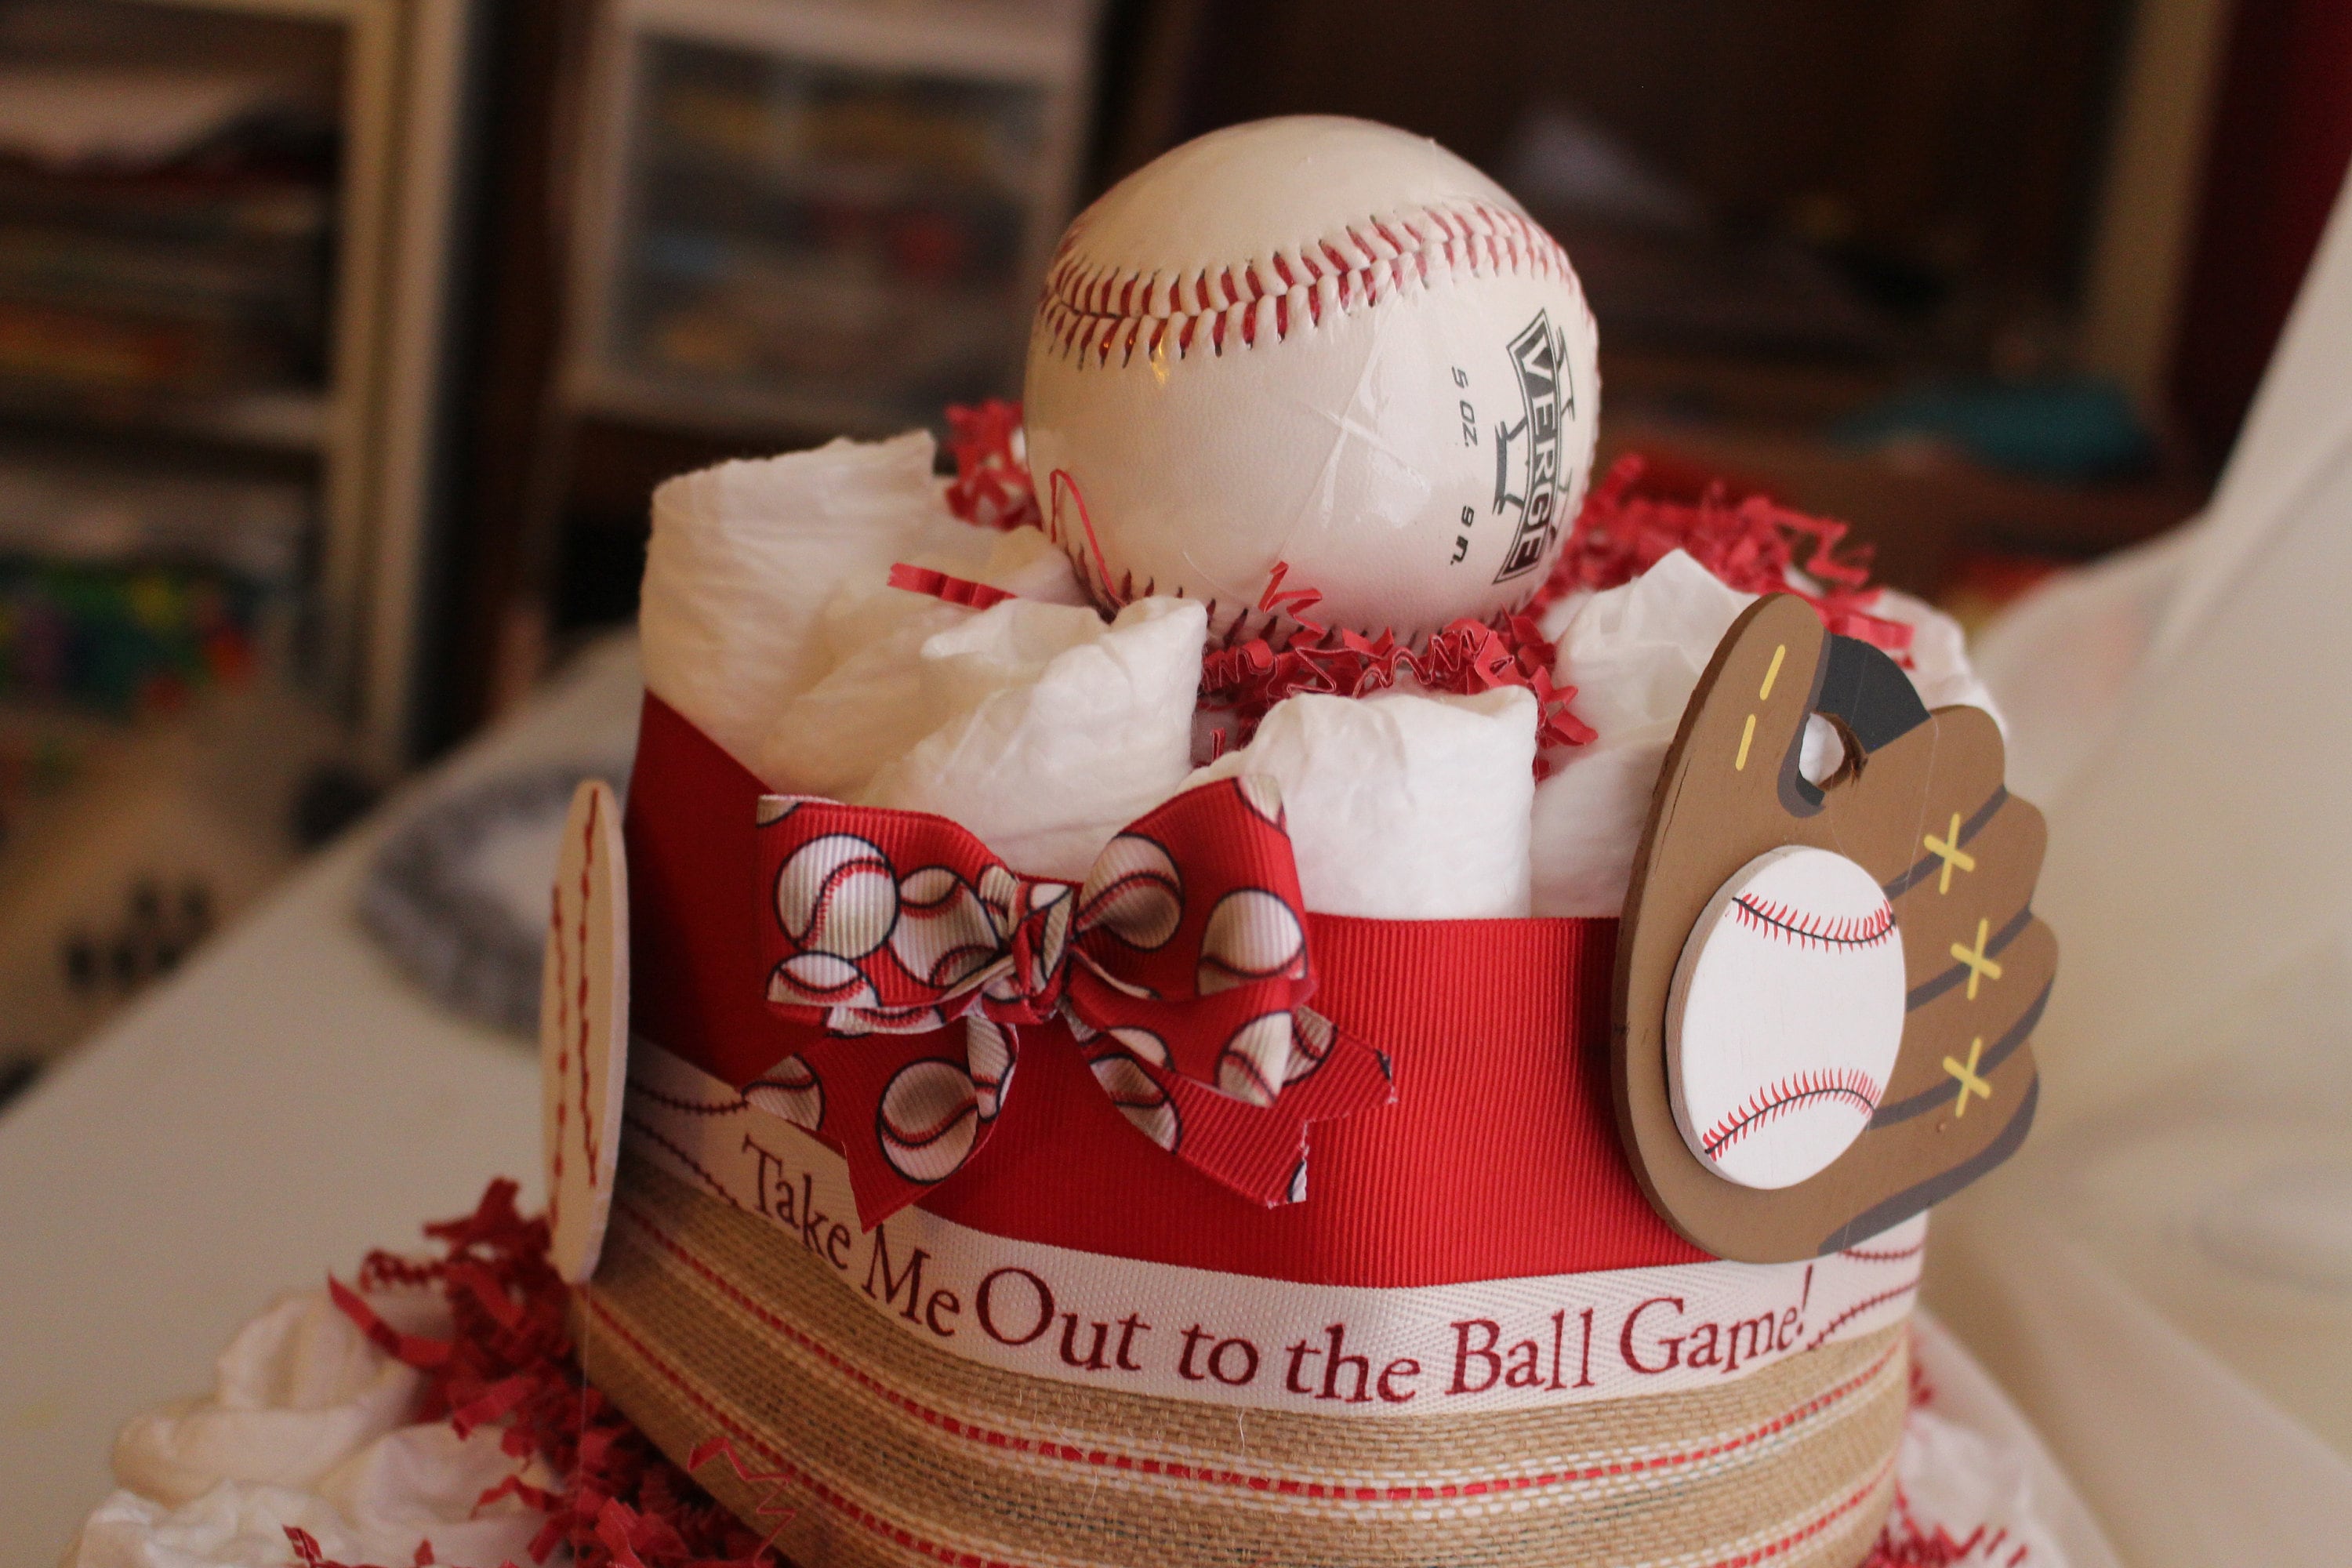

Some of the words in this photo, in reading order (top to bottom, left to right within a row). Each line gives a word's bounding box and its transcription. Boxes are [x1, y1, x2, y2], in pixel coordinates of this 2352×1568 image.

[1451, 365, 1469, 389] 5
[1461, 505, 1475, 528] 9
[1510, 331, 1557, 569] VERGE
[741, 1134, 851, 1270] Take
[862, 1223, 961, 1336] Me
[975, 1267, 1151, 1371] Out
[1177, 1323, 1259, 1386] to
[1284, 1323, 1421, 1403] the
[1445, 1307, 1595, 1396] Ball
[1619, 1264, 1813, 1374] Game!
